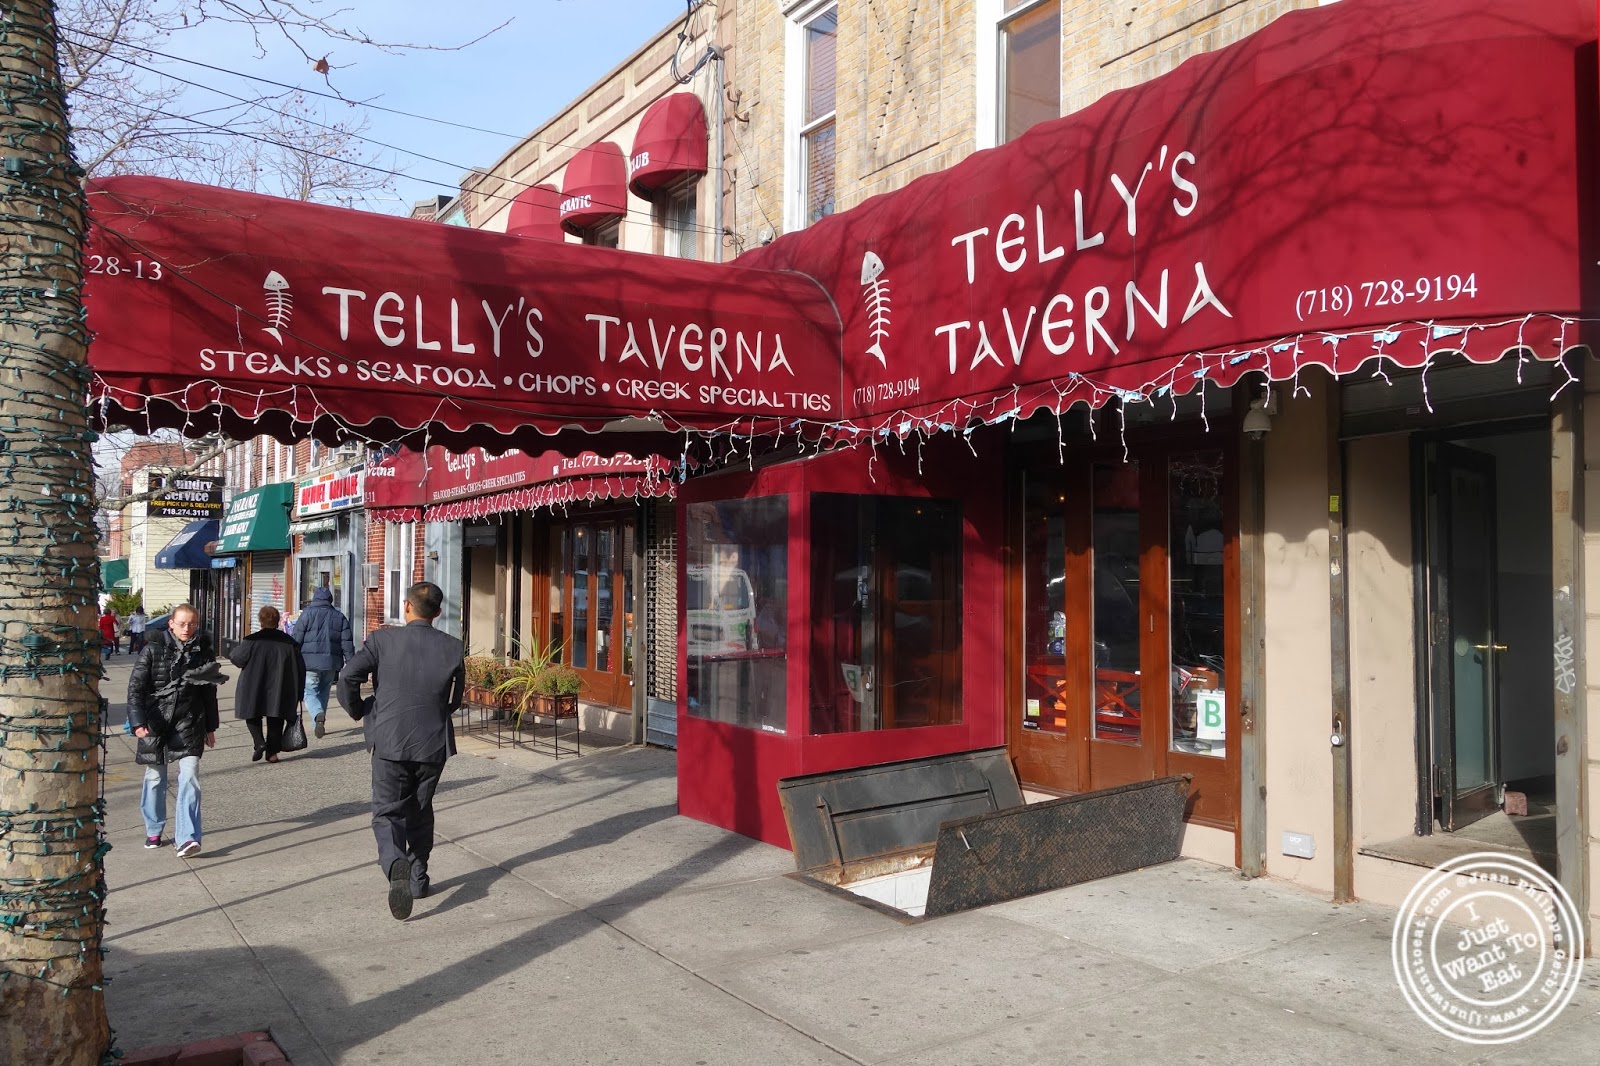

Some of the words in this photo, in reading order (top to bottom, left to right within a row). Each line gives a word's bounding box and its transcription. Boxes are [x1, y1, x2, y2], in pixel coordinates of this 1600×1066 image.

[951, 144, 1199, 284] TELLY'S
[89, 255, 163, 281] 28-13
[934, 262, 1233, 375] TAVERNA
[1295, 284, 1353, 322] (718)
[1360, 272, 1478, 307] 728-9194
[321, 286, 545, 358] TELLY'S
[585, 313, 795, 383] TAVERNA
[200, 348, 332, 378] STEAKS
[518, 372, 597, 395] CHOPS
[615, 378, 692, 401] GREEK
[699, 384, 832, 412] SPECIALTIES
[853, 386, 876, 409] (718)
[877, 377, 920, 401] 728-9194
[162, 508, 210, 516] 718.274.3118
[1205, 699, 1222, 728] B
